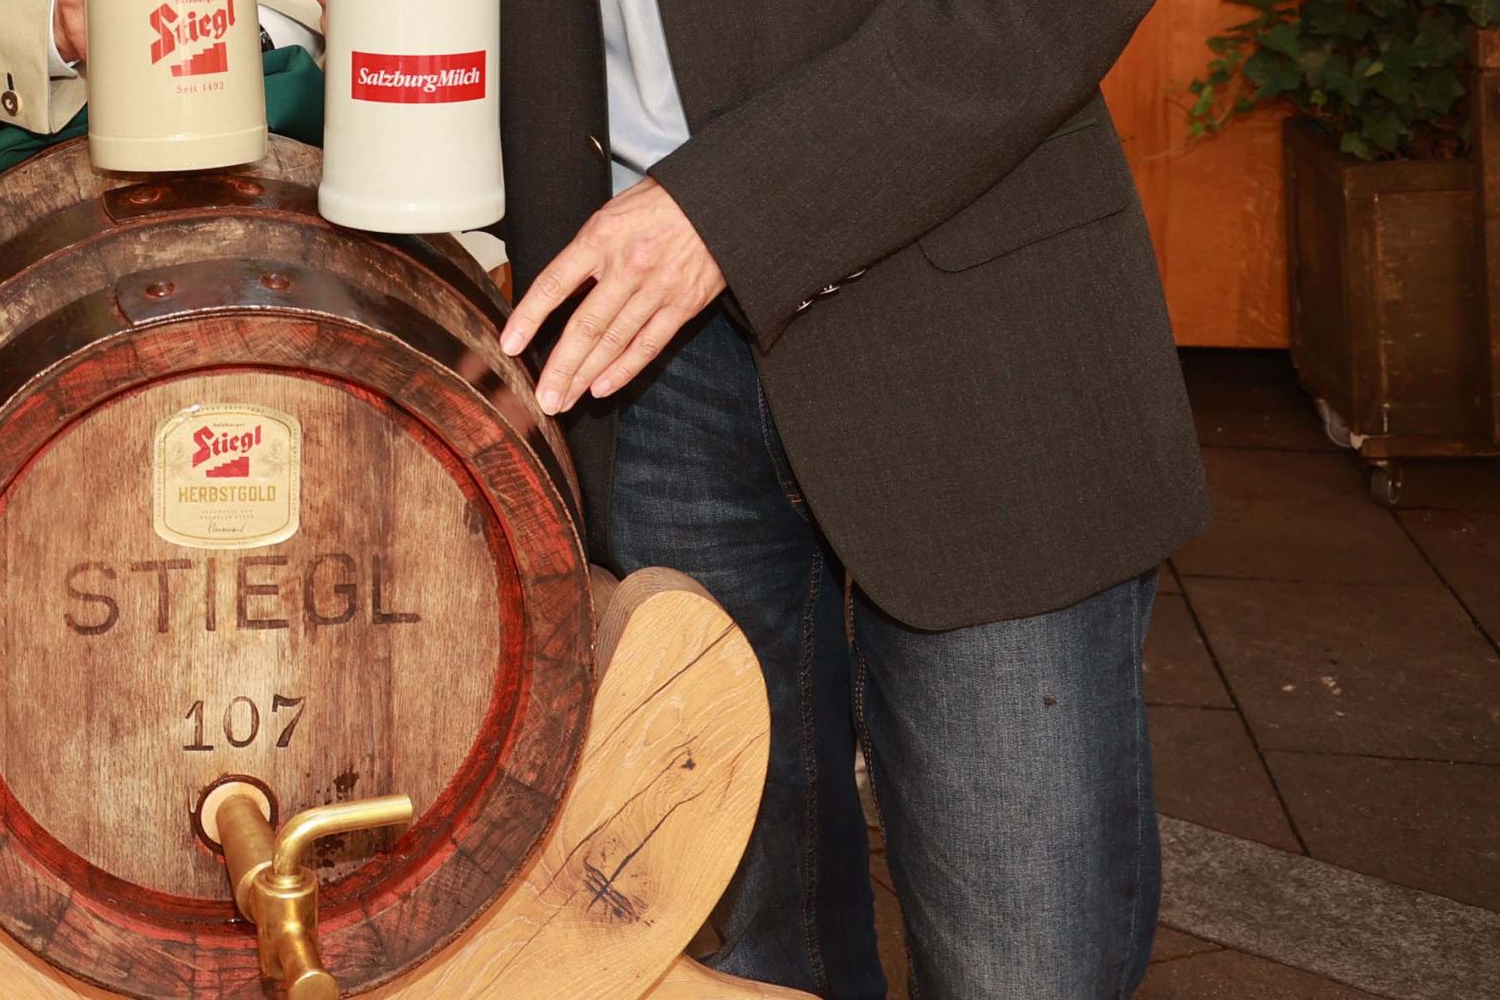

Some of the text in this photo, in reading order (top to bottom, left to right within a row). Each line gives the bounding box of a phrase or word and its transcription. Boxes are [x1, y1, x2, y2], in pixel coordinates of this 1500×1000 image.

[358, 67, 480, 93] SalzburgMilch
[192, 425, 262, 468] Stiegl
[178, 485, 277, 502] HERBSTGOLD
[63, 553, 422, 636] STIEGL
[182, 693, 307, 751] 107
